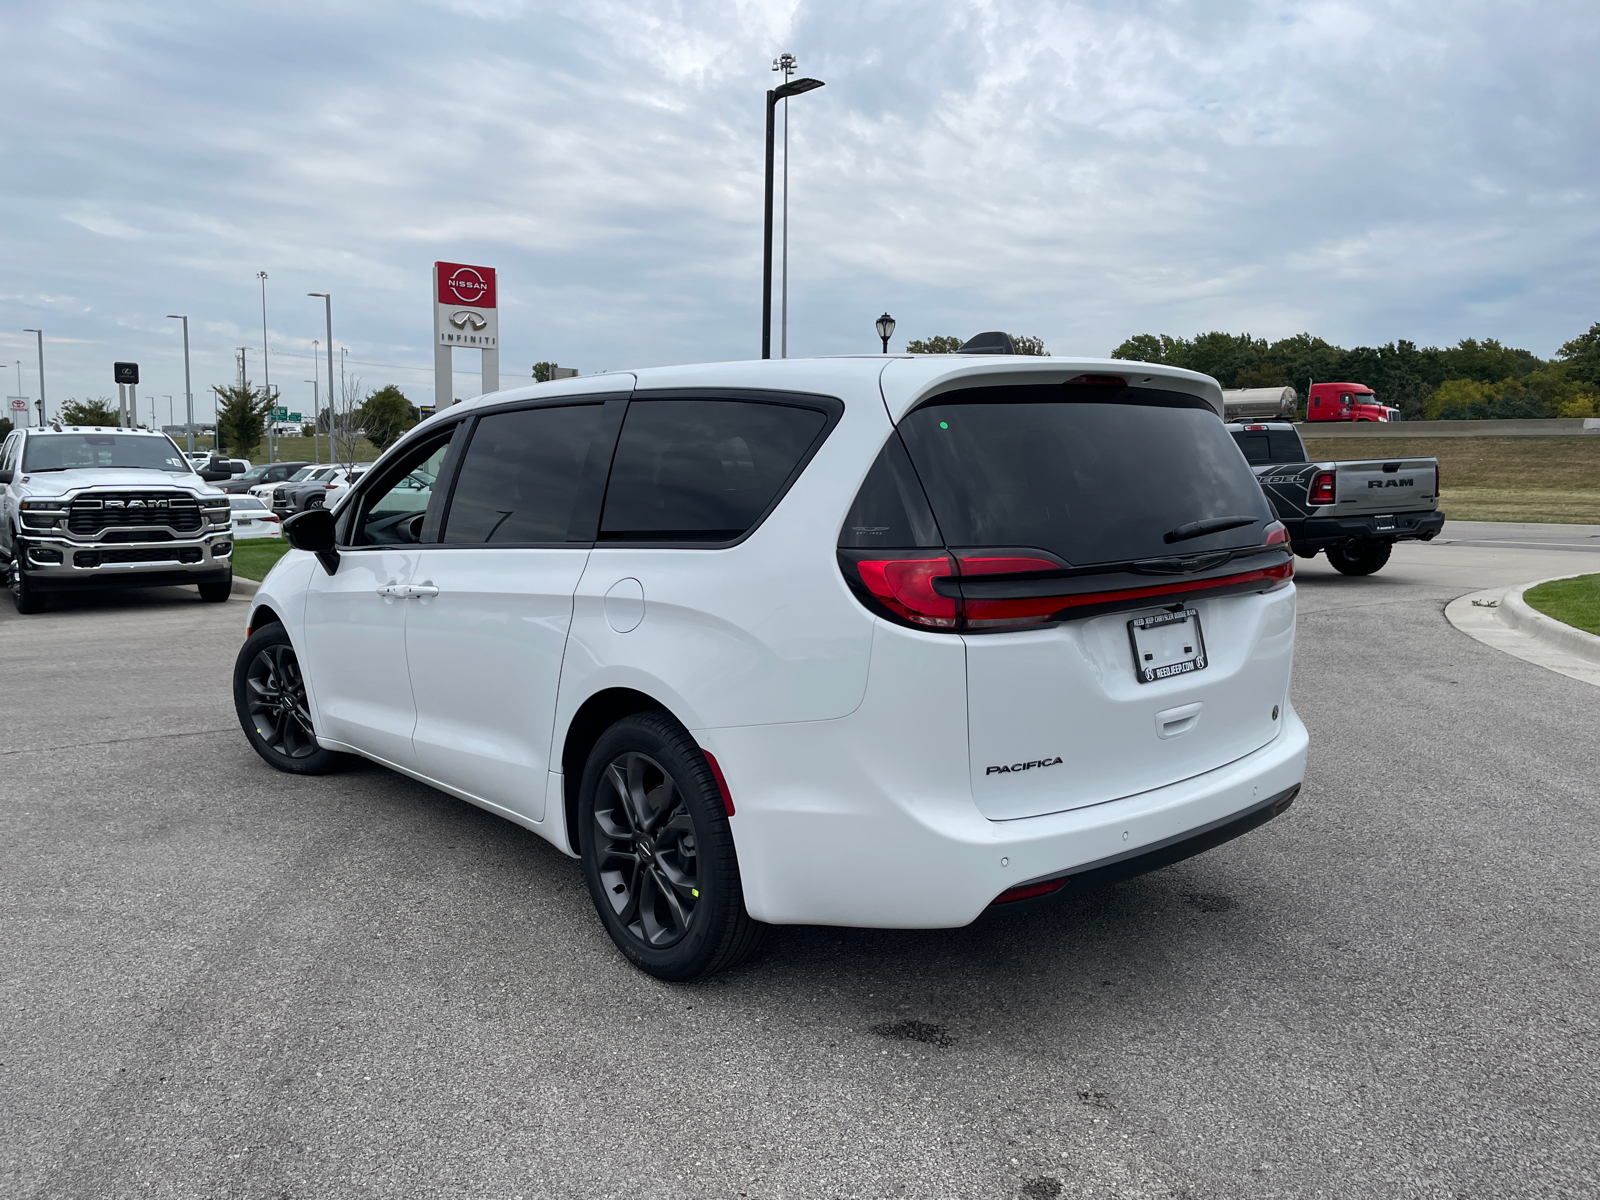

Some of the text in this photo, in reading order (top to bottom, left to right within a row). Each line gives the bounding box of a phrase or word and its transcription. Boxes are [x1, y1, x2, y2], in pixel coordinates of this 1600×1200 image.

[449, 280, 487, 290] NISSAN
[441, 333, 495, 344] INFINITI
[1368, 478, 1414, 488] RAM
[104, 500, 167, 508] RAM
[1156, 661, 1194, 679] REEDJEEP.COM
[986, 756, 1064, 775] PACIFICA
